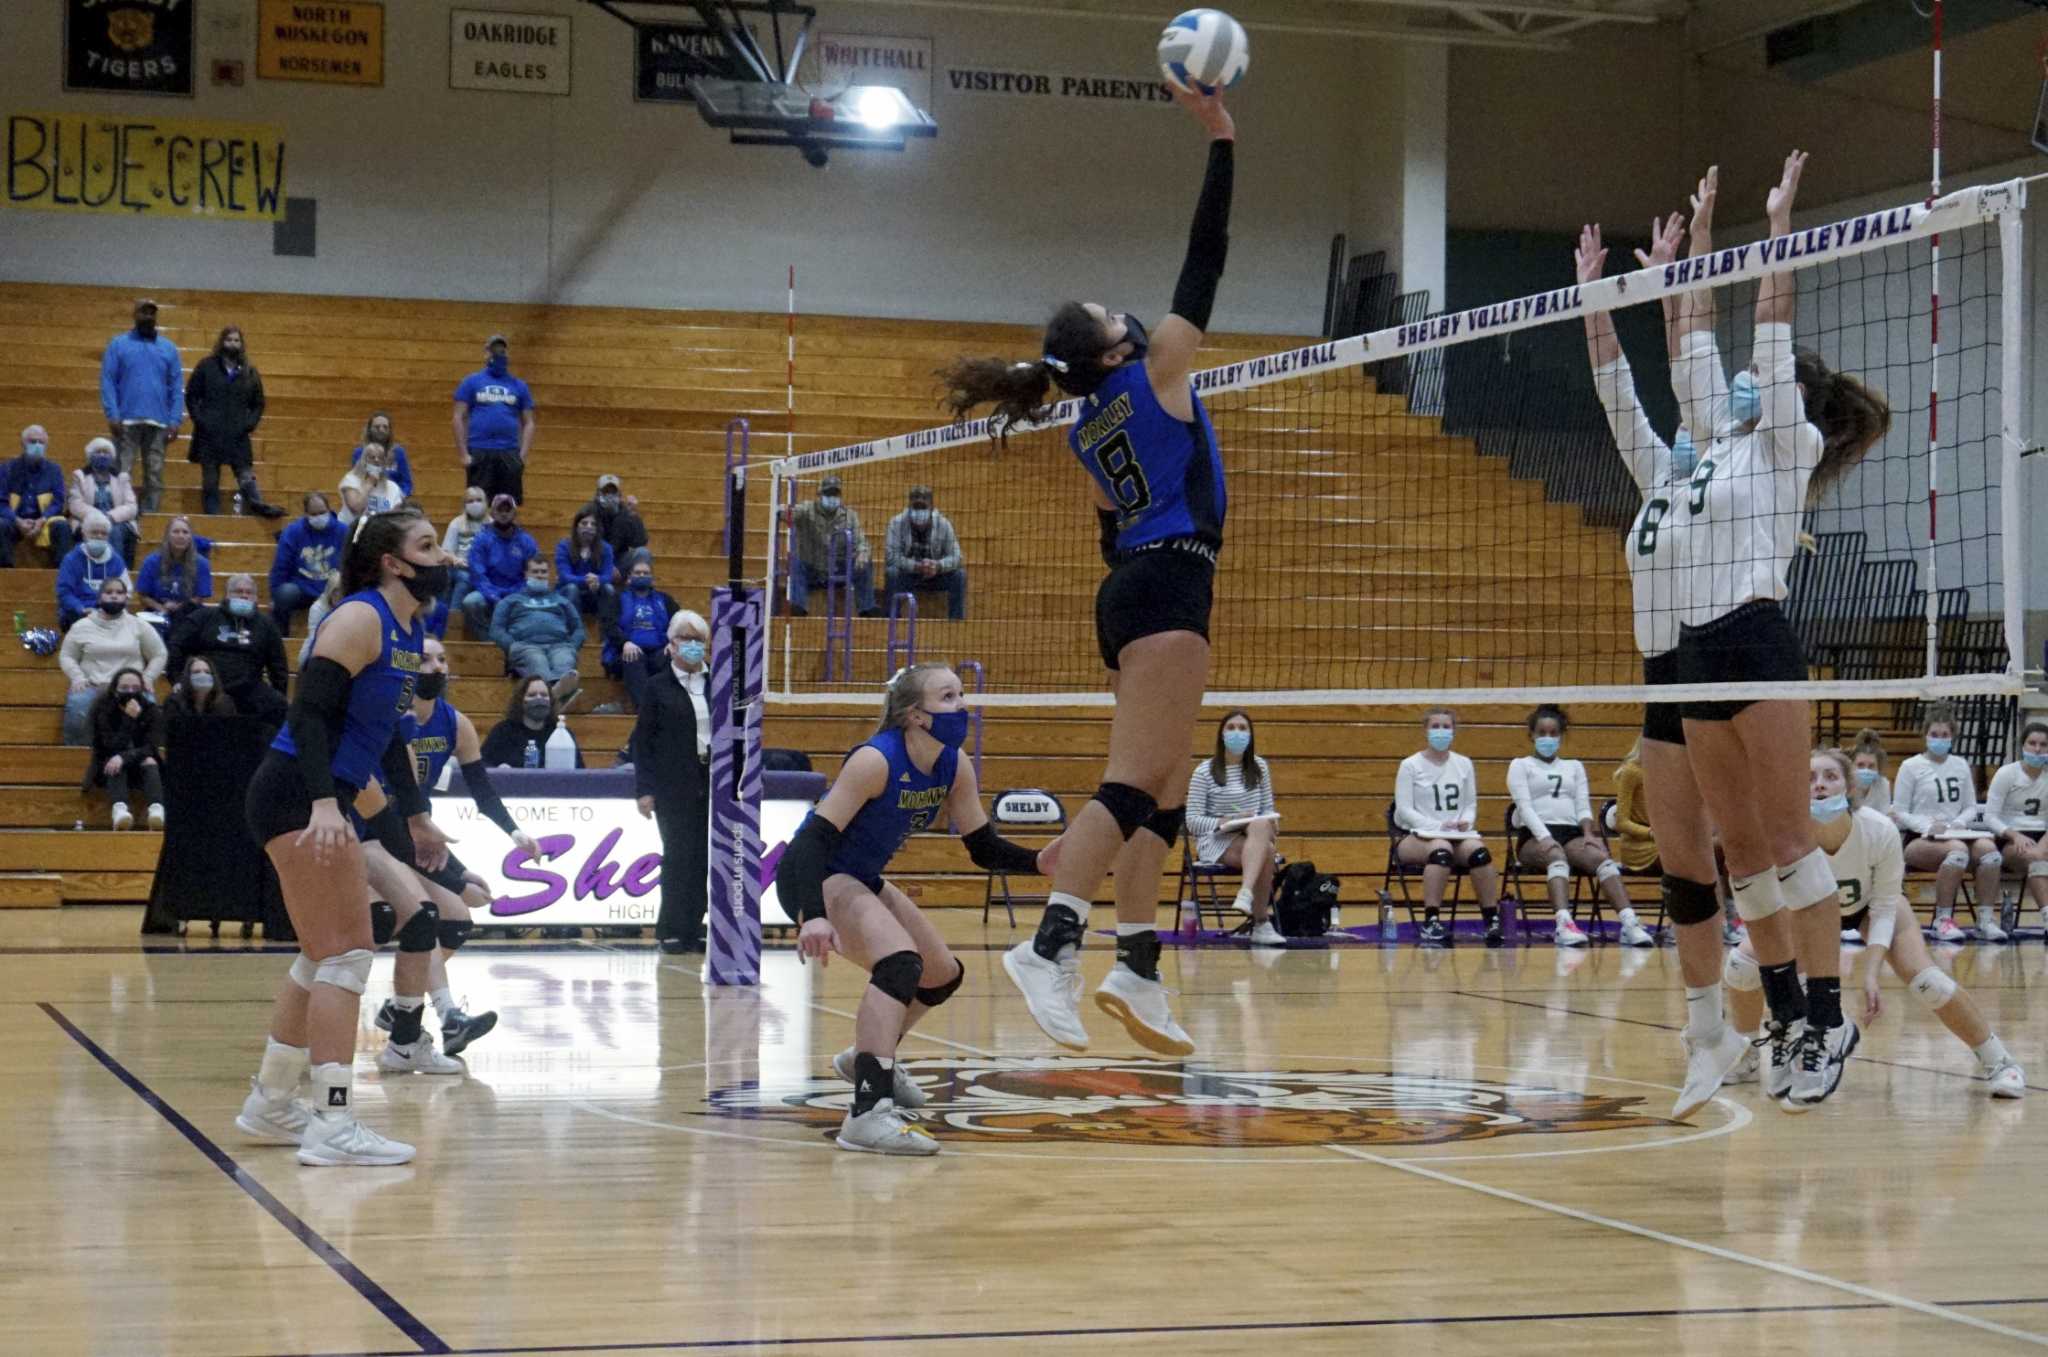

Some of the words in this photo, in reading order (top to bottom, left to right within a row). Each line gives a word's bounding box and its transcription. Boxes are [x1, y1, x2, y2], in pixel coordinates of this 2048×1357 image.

[292, 5, 351, 24] NORTH
[274, 25, 369, 46] MUSKEGON
[464, 22, 560, 47] OAKRIDGE
[87, 50, 177, 79] TIGERS
[279, 56, 362, 75] NORSEMEN
[474, 60, 548, 80] EAGLES
[824, 44, 926, 70] WHITEHALL
[948, 69, 1051, 95] VISITOR
[1060, 76, 1174, 103] PARENTS
[8, 116, 155, 210] BLUE
[167, 135, 286, 215] CREW
[1664, 244, 1750, 288] SHELBY
[1759, 206, 1913, 266] VOLLEYBALL
[1397, 313, 1463, 348] SHELBY
[1467, 287, 1583, 332] VOLLEYBALL
[1194, 363, 1246, 391] SHELBY
[1249, 343, 1337, 380] VOLLEYBALL
[1076, 391, 1135, 453] MORLEY
[1095, 429, 1152, 512] 8
[1688, 459, 1717, 516] 9
[1637, 498, 1671, 557] 8
[1431, 783, 1460, 811] 12
[1547, 774, 1563, 798] 7
[1934, 776, 1961, 803] 16
[569, 805, 595, 822] TO
[1004, 801, 1050, 813] SHELBY
[607, 903, 656, 920] HIGH
